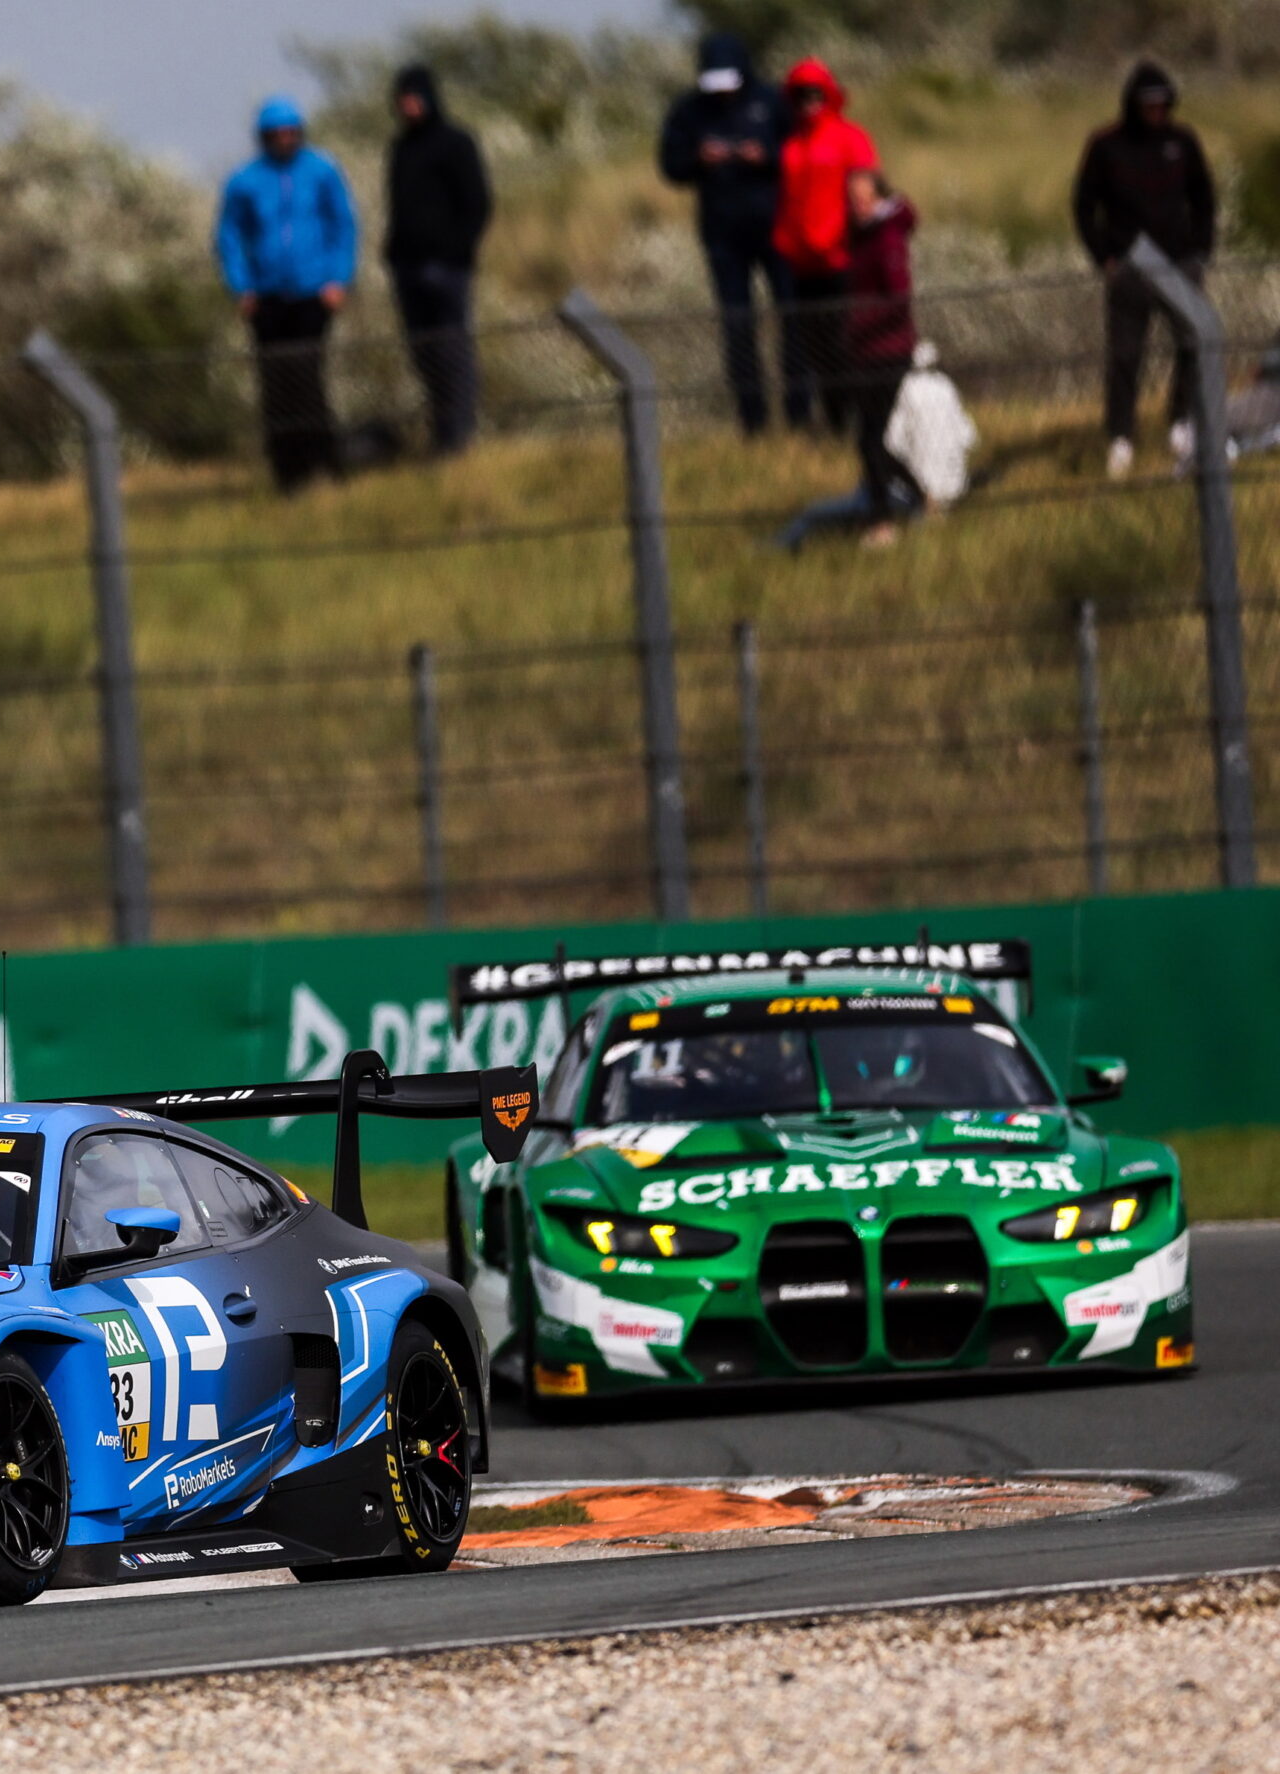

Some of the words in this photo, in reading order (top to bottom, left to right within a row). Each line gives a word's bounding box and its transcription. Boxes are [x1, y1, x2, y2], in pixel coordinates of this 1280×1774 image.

[492, 1096, 506, 1110] PME
[506, 1092, 531, 1108] LEGEND
[639, 1156, 1083, 1213] SCHAEFFLER
[96, 1430, 120, 1450] Ansys
[179, 1456, 236, 1497] RoboMarkets
